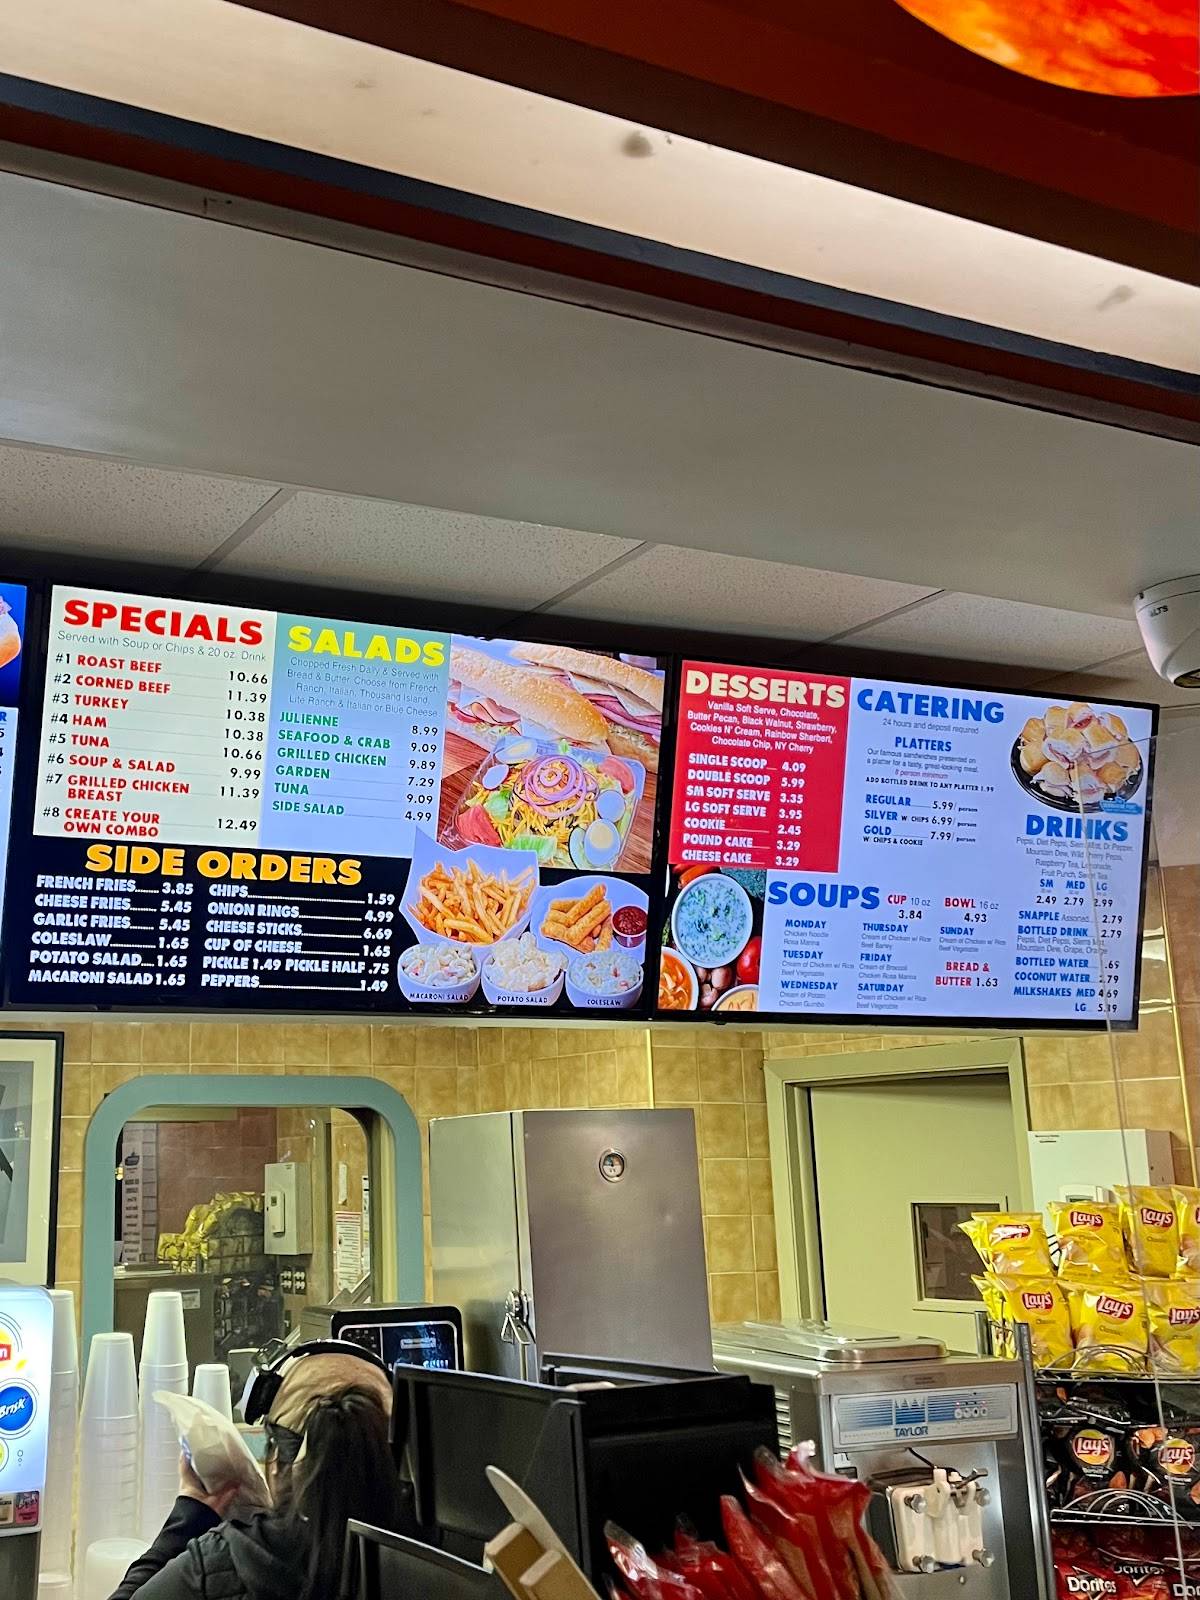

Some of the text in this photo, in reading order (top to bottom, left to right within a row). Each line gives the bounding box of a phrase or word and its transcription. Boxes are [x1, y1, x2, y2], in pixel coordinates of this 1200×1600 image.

[64, 600, 263, 645] SPECIALS
[58, 631, 94, 643] Served
[99, 637, 118, 646] with
[123, 638, 149, 650] Soup
[166, 643, 194, 655] Chips
[198, 647, 207, 655] &
[208, 648, 220, 657] 20
[241, 651, 266, 661] Drink
[288, 625, 445, 667] SALADS
[56, 653, 268, 684] #1 ROAST BEEF 10.66
[54, 674, 267, 703] #2 CORNED BEEF 11.39
[329, 686, 356, 696] Italian,
[360, 689, 400, 700] Thousand
[686, 670, 845, 708] DESSERTS
[52, 693, 265, 723] #3 TURKEY 10.38
[857, 689, 1004, 723] CATERING
[50, 713, 264, 742] #4 HAM 10.38
[280, 712, 438, 736] JULIENNE 8.99
[50, 734, 262, 760] #5 TUNA 10.66
[278, 730, 437, 753] SEAFOOD & CRAB 9.09
[895, 736, 952, 752] PLATTERS
[48, 754, 261, 780] #6 SOUP & SALAD 9.99
[277, 748, 435, 770] GRILLED CHICKEN 9.89
[689, 753, 806, 773] SINGLE SCOOP 4.09
[276, 765, 434, 787] GARDEN 7.29
[688, 769, 805, 788] DOUBLE SCOOP 5.99
[46, 774, 260, 798] #7 GRILLED CHICKEN 11.39
[275, 783, 433, 804] TUNA 9.09
[68, 789, 123, 802] BREAST
[866, 794, 911, 807] REGULAR
[43, 807, 257, 831] #8 CREATE YOUR 12.49
[273, 801, 432, 821] SIDE SALAD 4.99
[865, 810, 897, 820] SILVER
[64, 822, 158, 837] OWN COMBO
[684, 818, 801, 835] COOKIE 2.45
[864, 825, 891, 836] GOLD
[1026, 815, 1129, 842] DRINKS
[85, 844, 362, 886] SIDE ORDERS
[36, 874, 193, 895] FRENCH FRIES 3.85
[1040, 879, 1107, 891] SM MED LG
[209, 883, 395, 905] CHIPS 1.59
[768, 881, 880, 909] SOUPS
[888, 895, 907, 904] CUP
[911, 897, 920, 906] 10
[1036, 896, 1056, 904] 2.49
[1064, 897, 1084, 906] 2.79
[944, 898, 976, 908] BOWL
[980, 901, 988, 909] 16
[208, 902, 394, 923] ONION RINGS 4.99
[898, 910, 922, 920] 3.84
[964, 913, 987, 922] 4.93
[1019, 911, 1123, 923] SNAPPLE 2.79
[206, 920, 392, 940] CHEESE STICKS 6.69
[785, 919, 826, 928] MONDAY
[863, 923, 908, 932] THURSDAY
[940, 927, 974, 936] SUNDAY
[1018, 925, 1122, 938] BOTTLED DRINK 2.79
[32, 931, 189, 950] COLESLAW 1.65
[30, 950, 187, 968] POTATO SALAD 1.65
[783, 950, 823, 959] TUESDAY
[860, 953, 892, 962] FRIDAY
[1016, 957, 1089, 968] BOTTLED WATER
[946, 962, 990, 972] BREAD &
[201, 974, 388, 992] PEPPERS 1.49
[781, 981, 838, 990] WEDNESDAY
[936, 976, 998, 987] BUTTER 1.63
[1015, 971, 1090, 983] COCONUT WATER
[858, 984, 904, 992] SATURDAY
[1014, 987, 1095, 997] MILKSHAKES MED
[497, 995, 524, 1003] POTATO
[1075, 1003, 1086, 1012] LG
[894, 1425, 929, 1437] TAYLOR
[1067, 1576, 1117, 1593] Doritos
